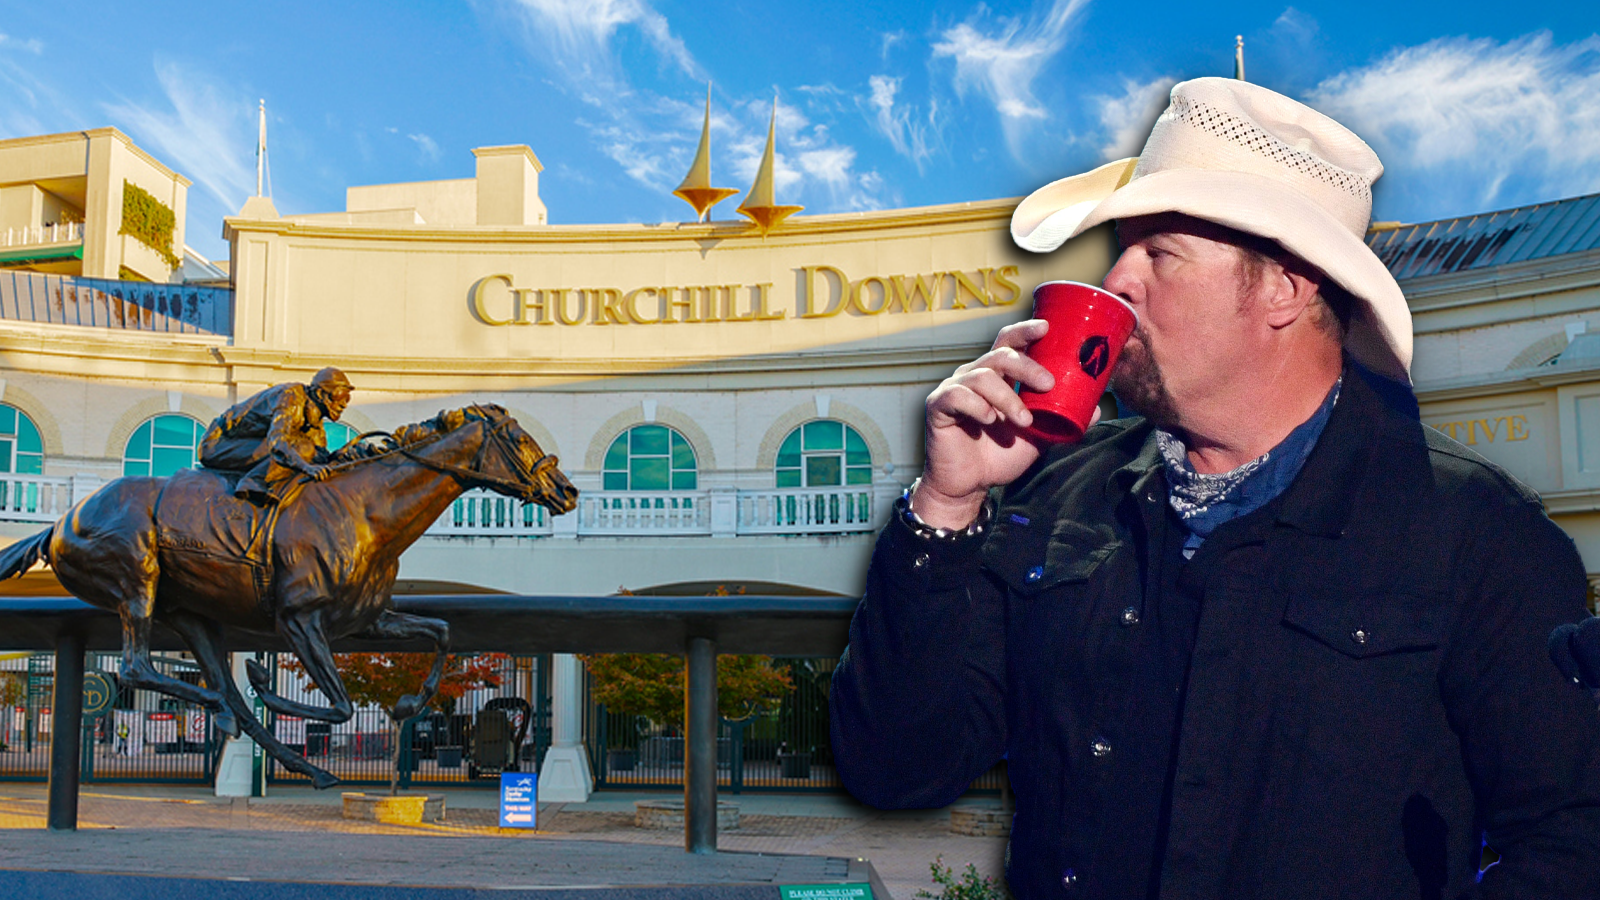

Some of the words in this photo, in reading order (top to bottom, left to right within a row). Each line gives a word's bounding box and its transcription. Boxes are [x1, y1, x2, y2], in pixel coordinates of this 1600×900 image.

[473, 273, 786, 326] CHURCHILL
[800, 265, 1022, 319] DOWNS
[1431, 414, 1530, 446] TIVE
